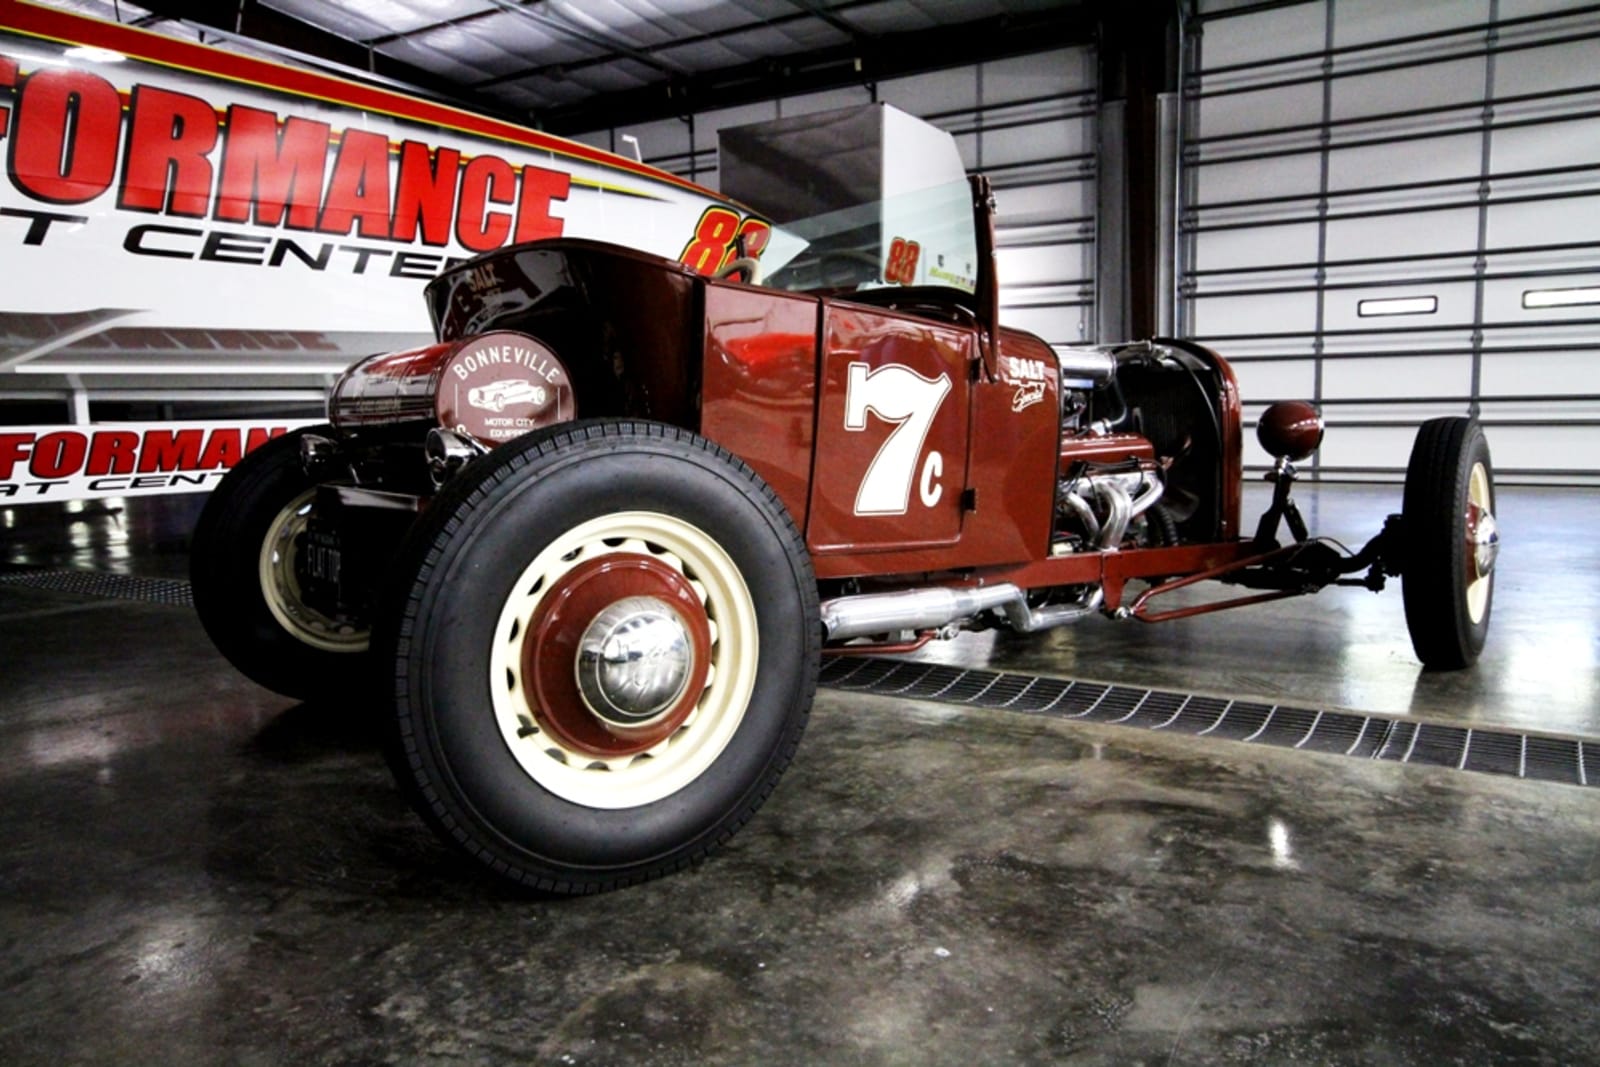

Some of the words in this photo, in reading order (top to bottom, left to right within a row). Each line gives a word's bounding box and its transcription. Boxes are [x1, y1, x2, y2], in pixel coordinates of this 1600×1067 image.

[0, 56, 572, 253] ORMANCE
[885, 236, 920, 287] 88
[452, 346, 560, 383] BONNEVILLE
[1009, 356, 1044, 380] SALT
[484, 418, 514, 427] MOTOR
[516, 418, 535, 427] CITY
